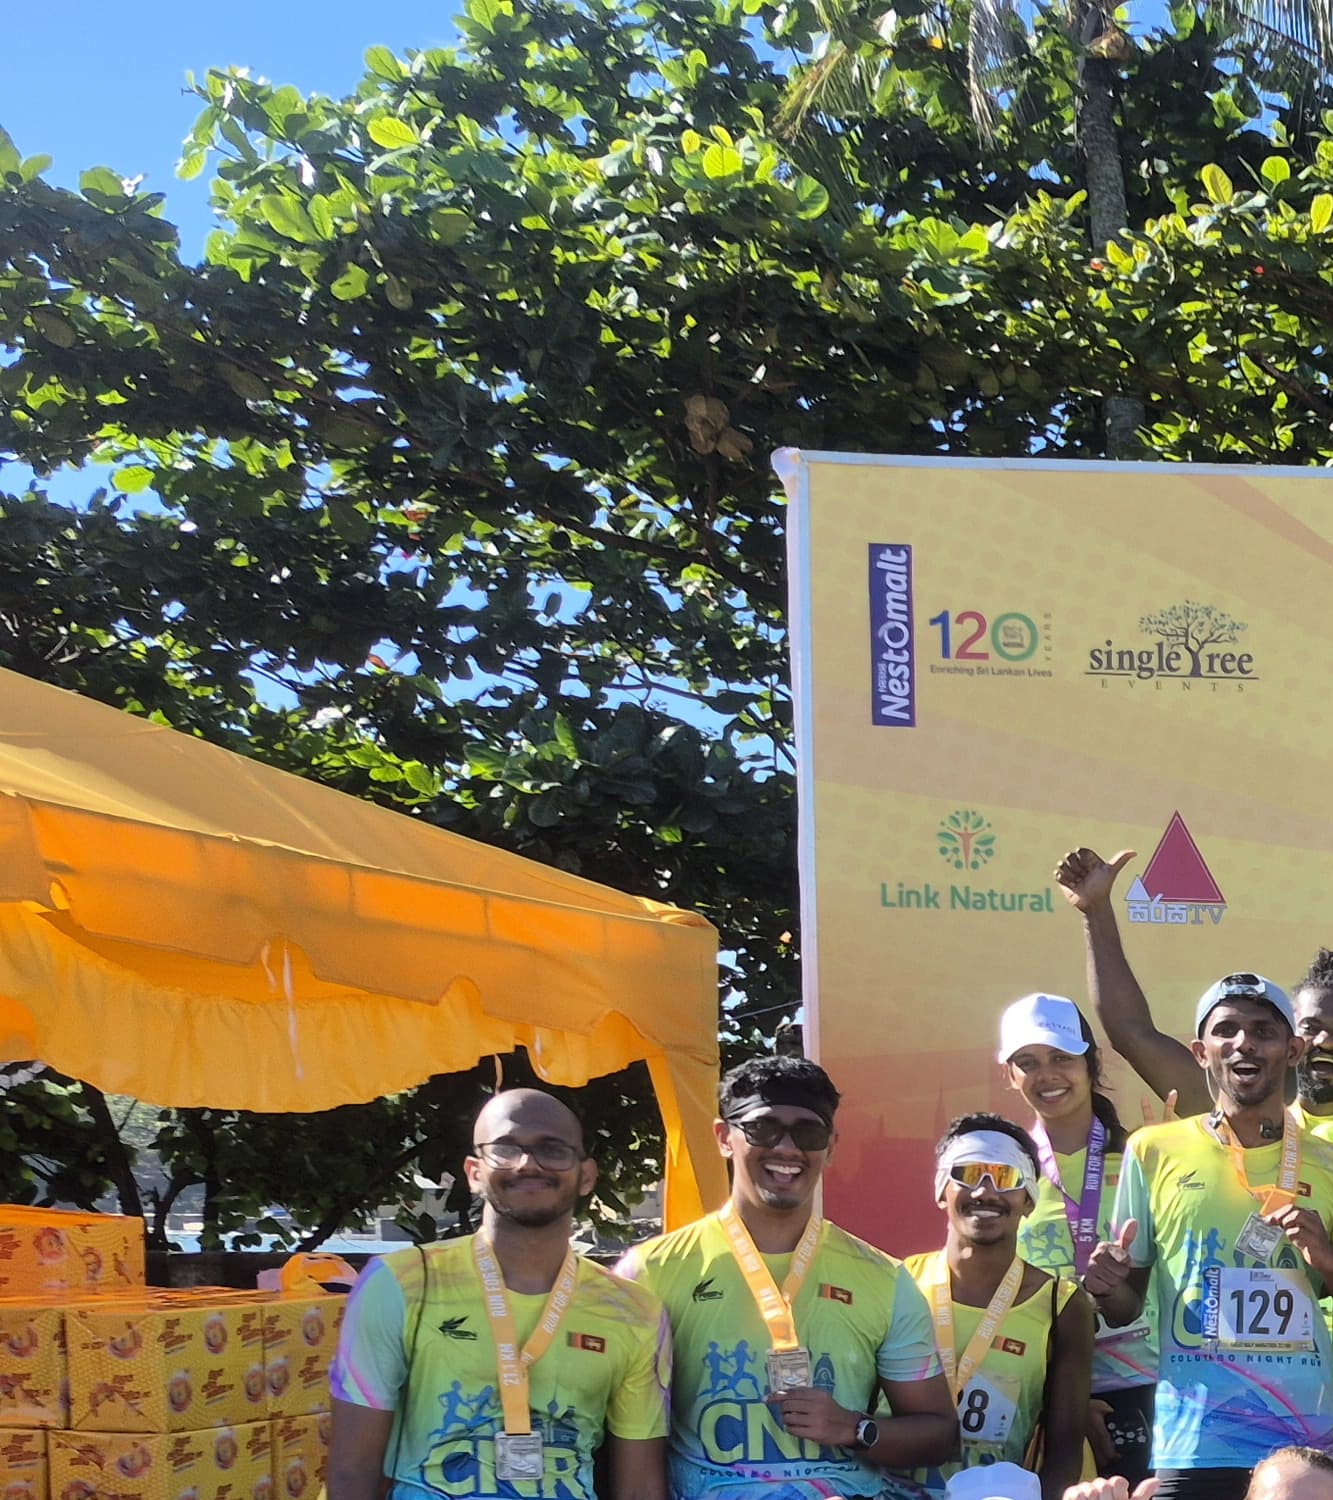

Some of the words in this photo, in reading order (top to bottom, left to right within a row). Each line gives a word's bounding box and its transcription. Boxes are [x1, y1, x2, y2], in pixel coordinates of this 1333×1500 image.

[929, 610, 1038, 662] 120
[1089, 640, 1182, 680] single
[930, 665, 974, 677] Enriching
[976, 666, 989, 675] Sri
[991, 667, 1025, 676] Lankan
[1028, 667, 1053, 677] Lives
[1101, 680, 1244, 692] EVENTS
[880, 883, 940, 909] Link
[950, 886, 1055, 913] Natural
[1087, 1155, 1101, 1172] FOR
[1086, 1171, 1099, 1190] RUN
[1080, 1217, 1095, 1234] KM
[543, 1308, 561, 1335] RUN
[1230, 1289, 1294, 1335] 129
[1247, 1354, 1293, 1365] NIGHT
